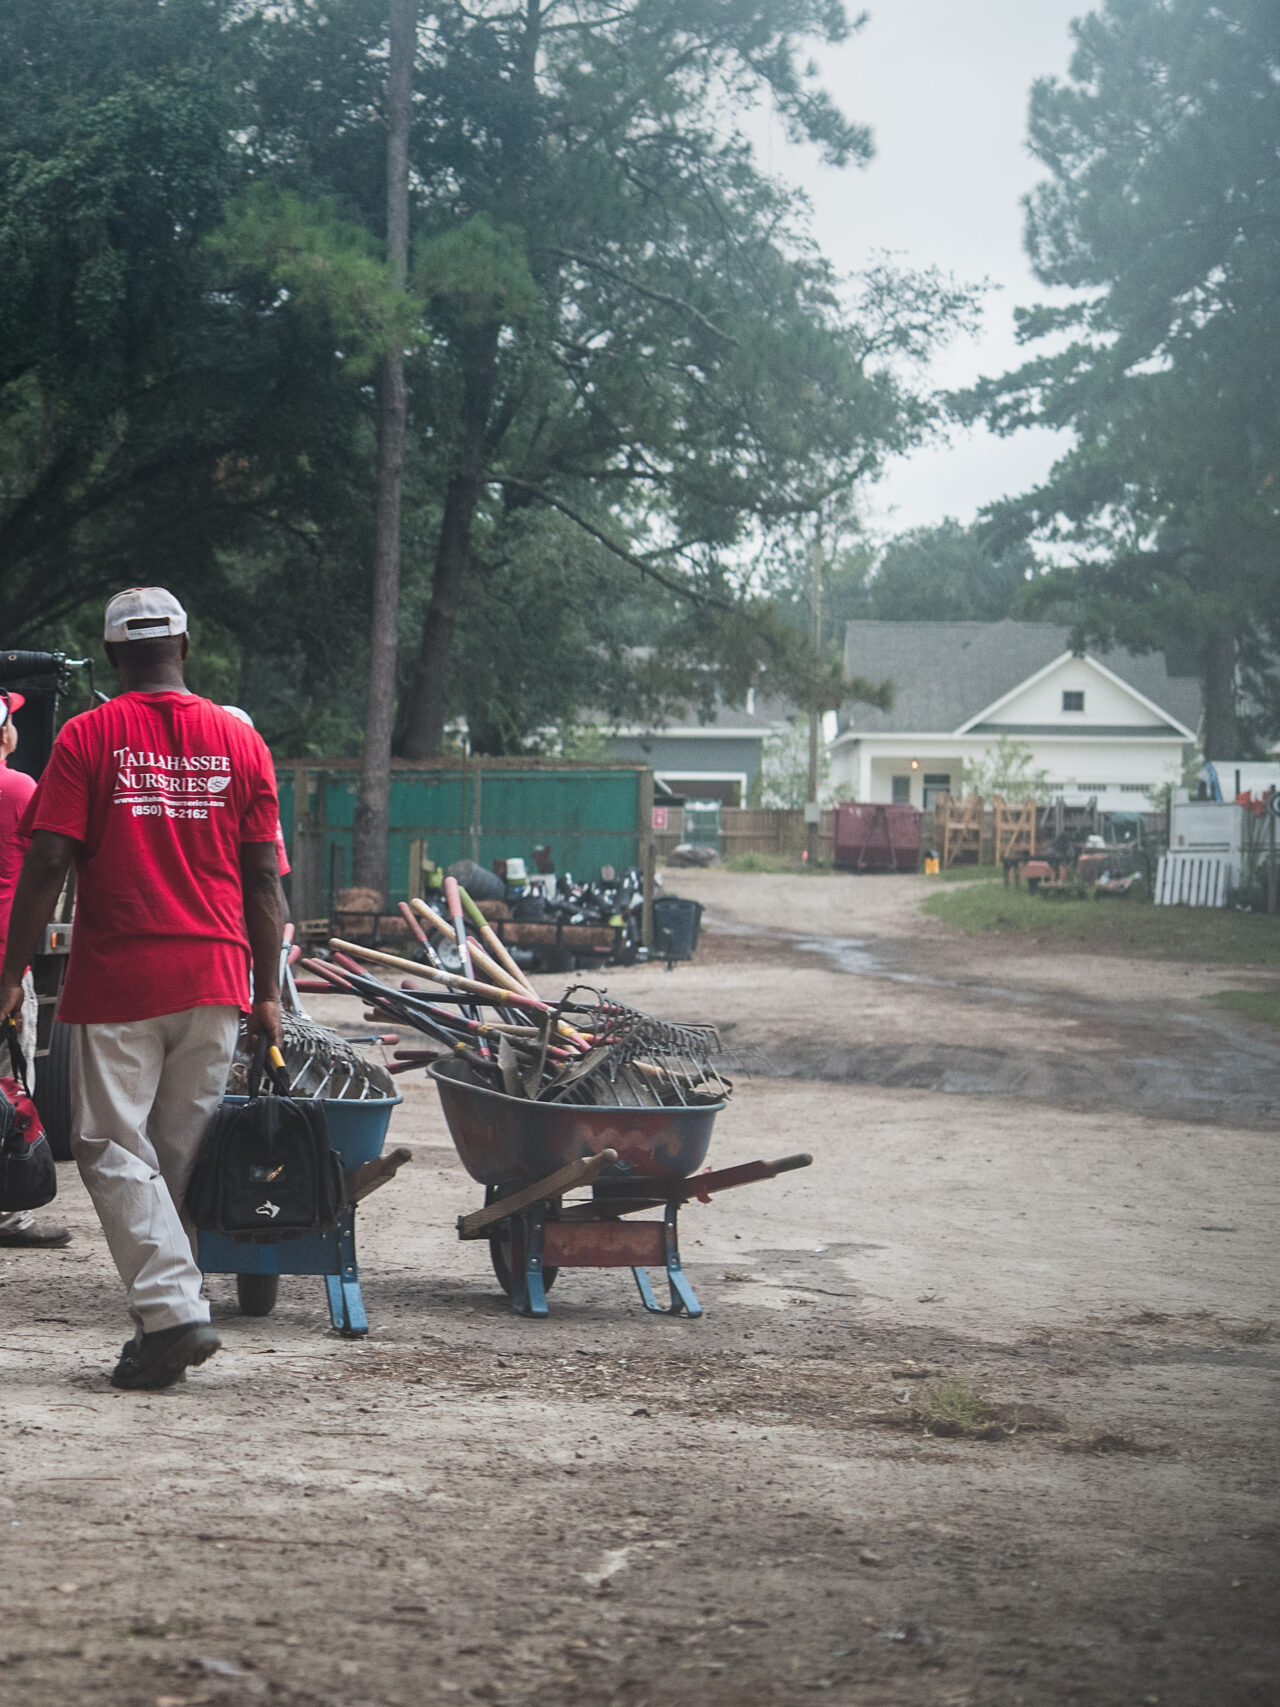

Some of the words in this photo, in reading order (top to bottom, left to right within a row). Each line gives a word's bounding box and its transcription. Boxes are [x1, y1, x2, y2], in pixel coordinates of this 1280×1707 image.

[113, 746, 231, 771] TALLAHASSEE
[115, 768, 208, 792] NURSERIES
[131, 805, 162, 817] (850)
